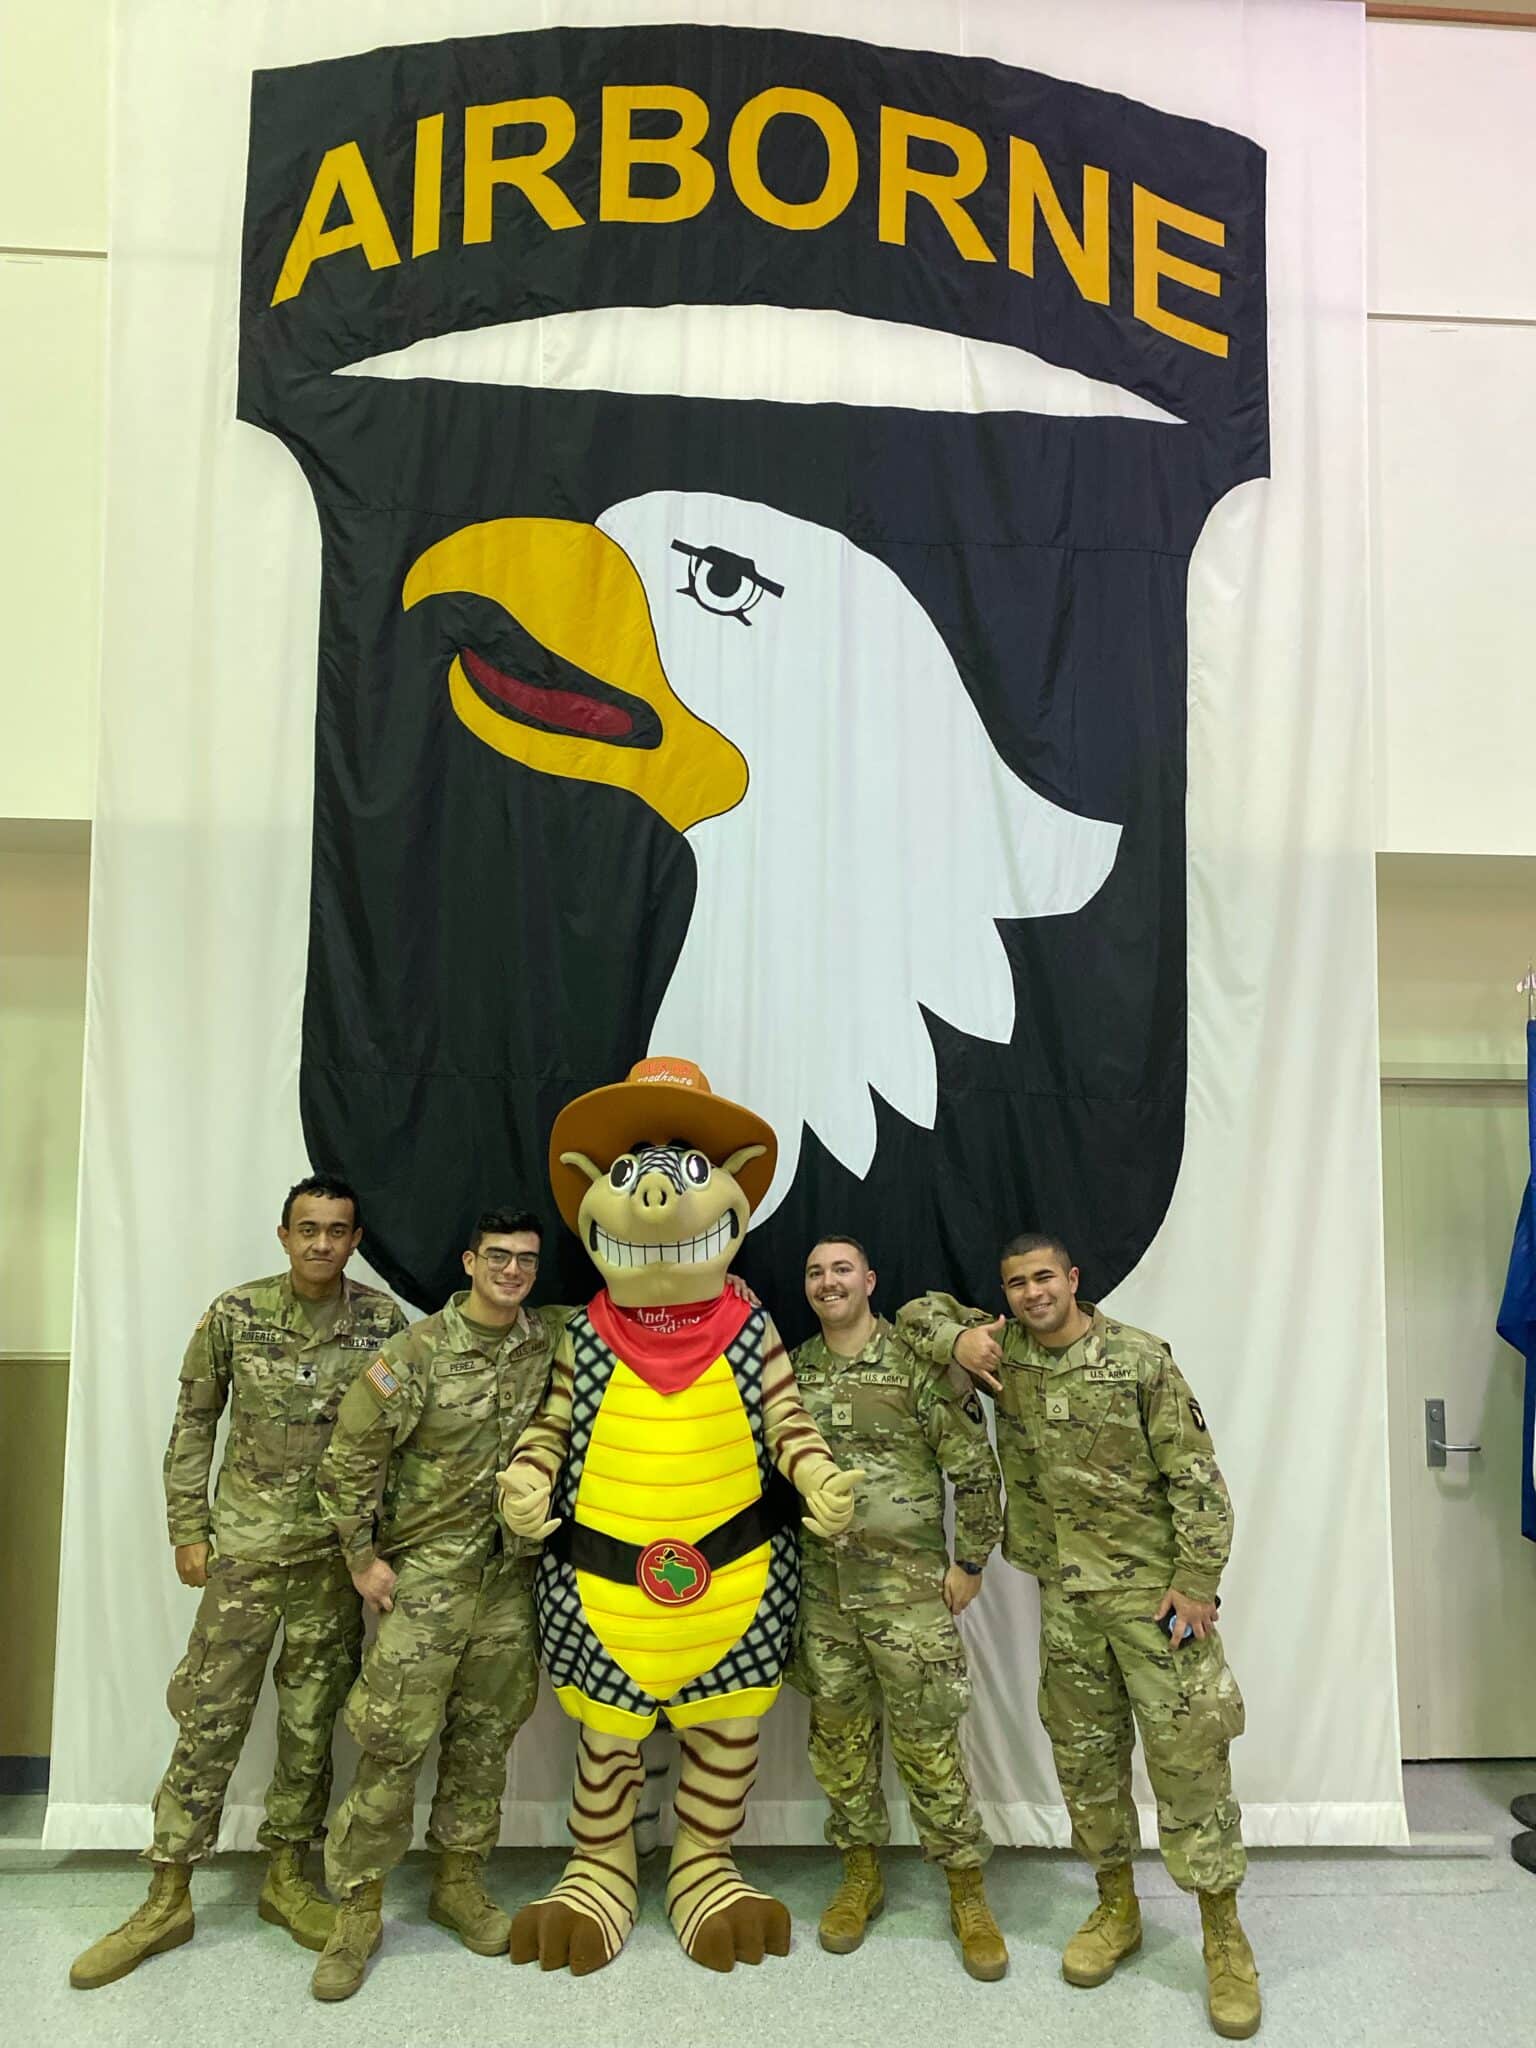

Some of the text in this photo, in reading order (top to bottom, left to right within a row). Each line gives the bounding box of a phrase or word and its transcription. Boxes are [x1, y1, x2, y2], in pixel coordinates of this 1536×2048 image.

[271, 85, 1229, 358] AIRBORNE
[450, 1361, 475, 1373] PEREZ
[1108, 1369, 1132, 1379] ARMY
[881, 1375, 905, 1385] ARMY
